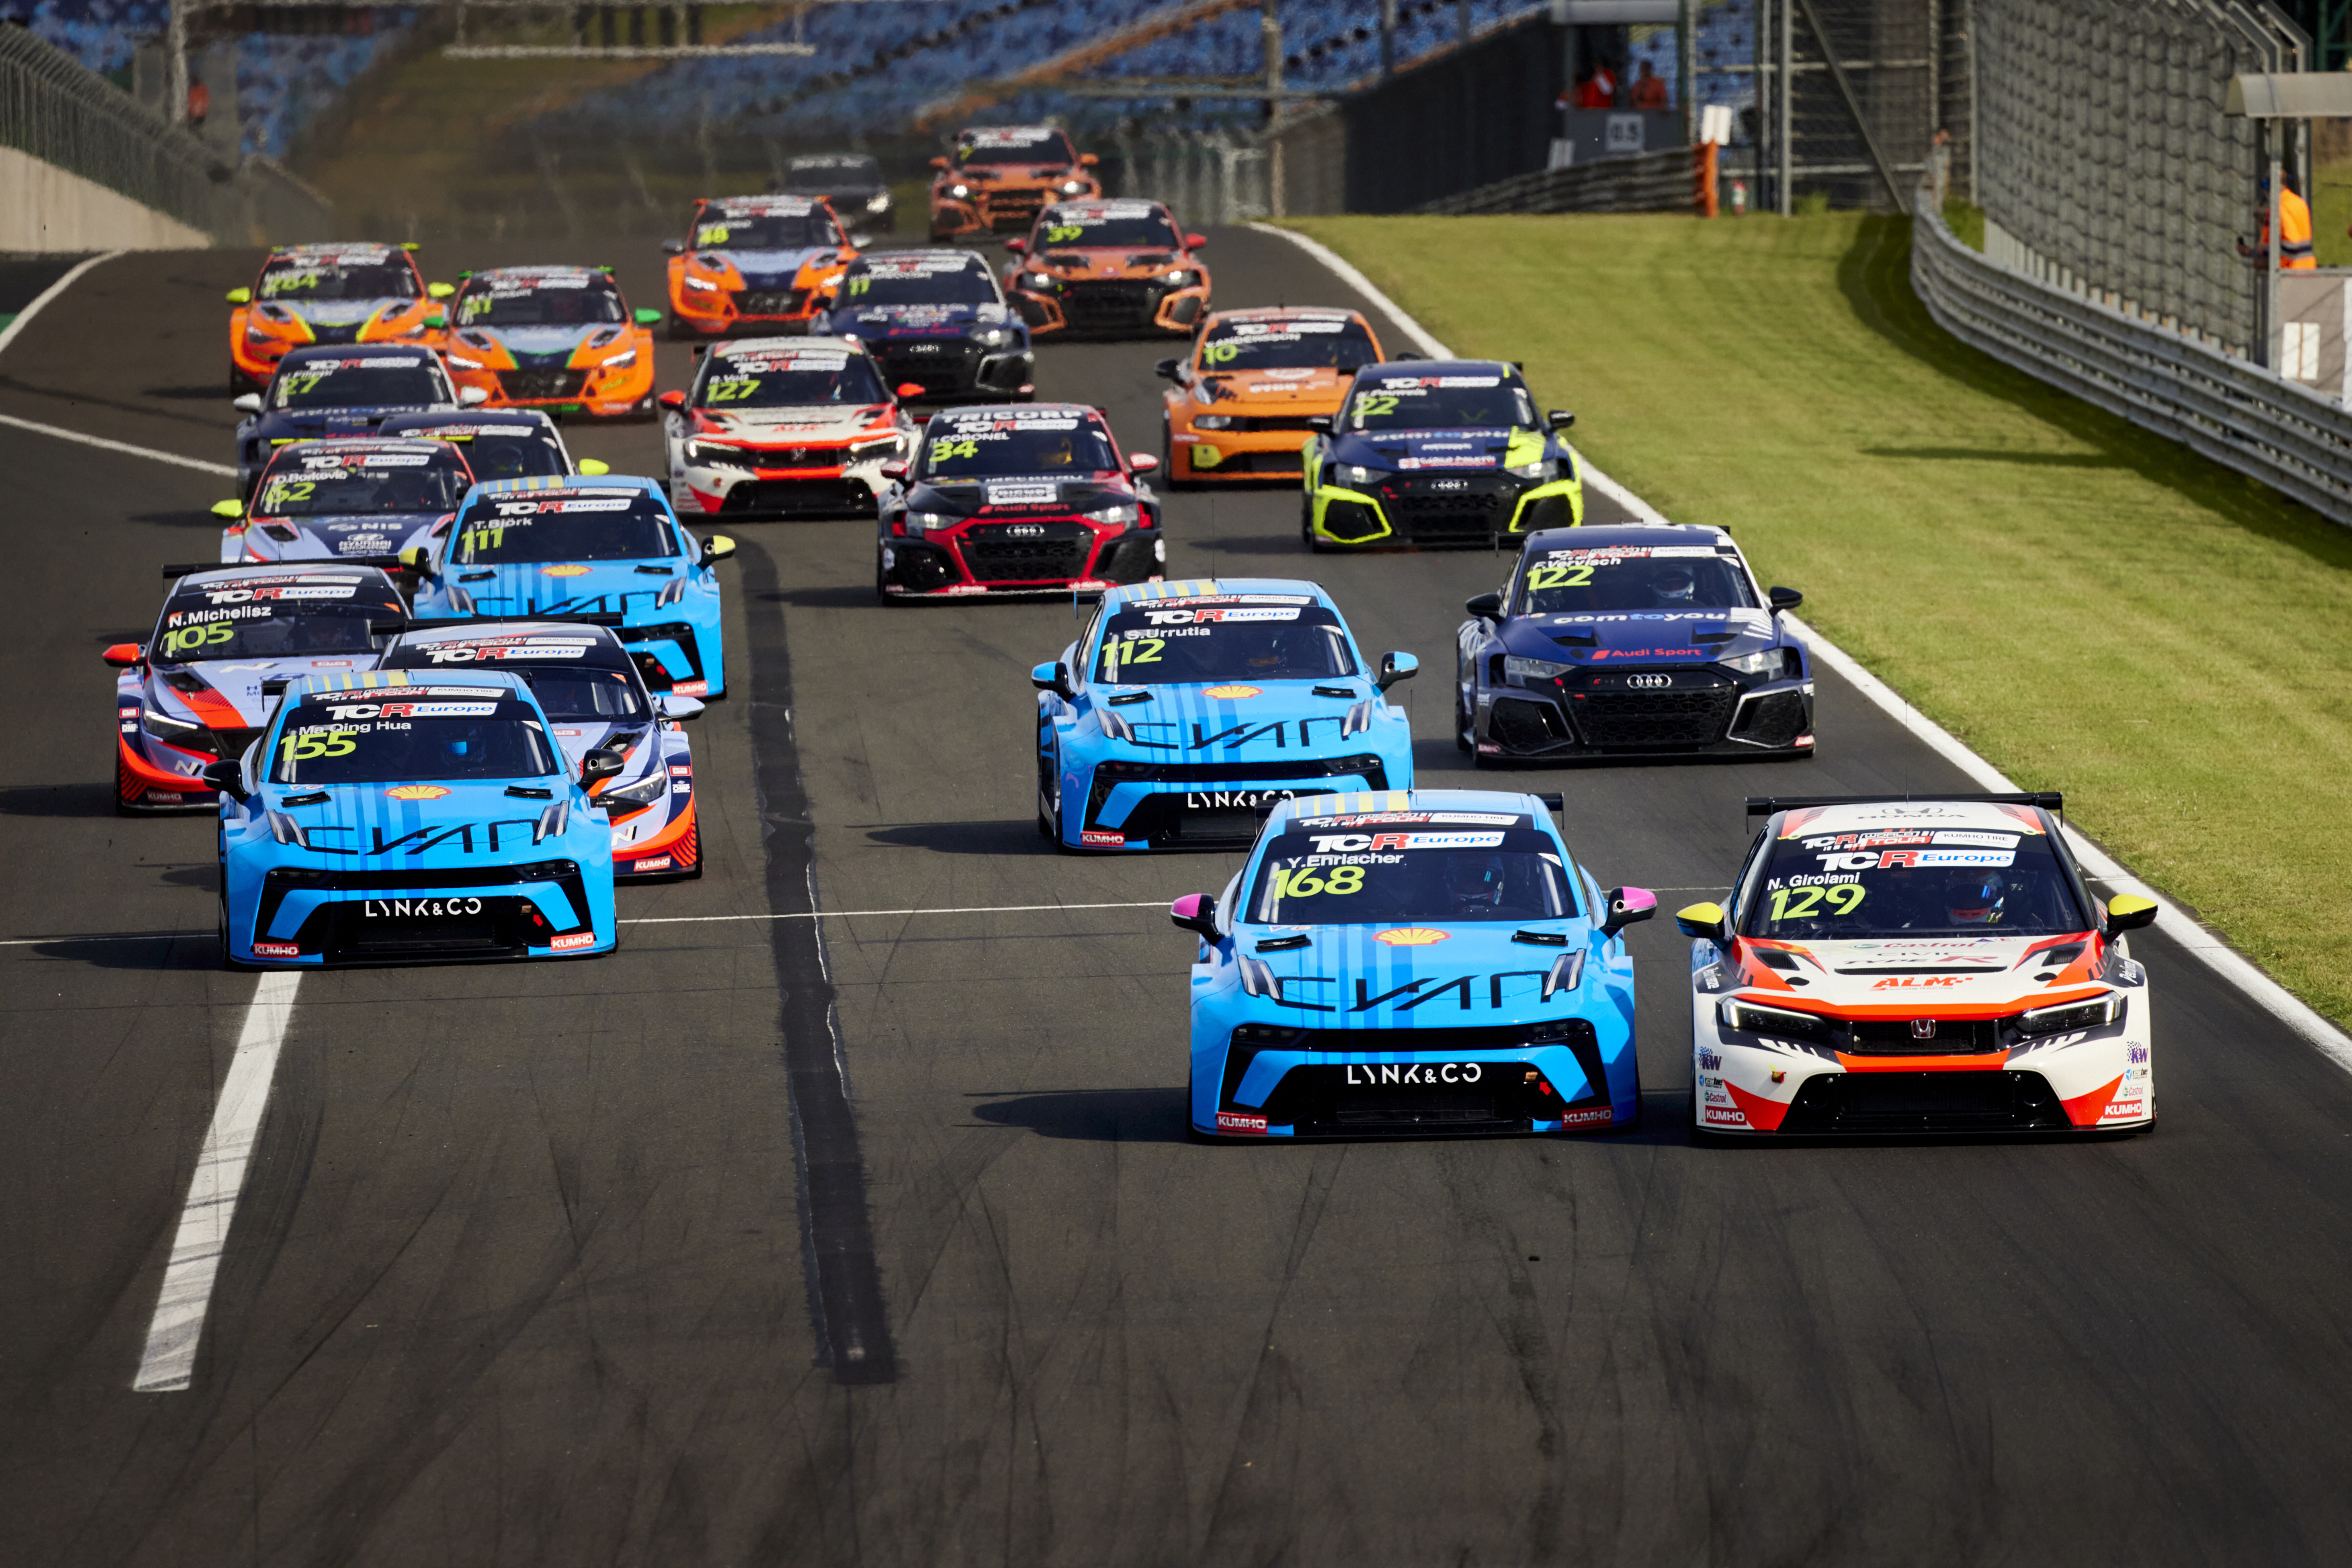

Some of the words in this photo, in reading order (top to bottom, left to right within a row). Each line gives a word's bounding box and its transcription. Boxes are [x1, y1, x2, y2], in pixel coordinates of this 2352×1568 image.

[1046, 226, 1083, 243] 39
[849, 279, 871, 296] 11
[1203, 343, 1238, 363] 10
[279, 376, 321, 396] 27
[707, 380, 761, 402] 127
[1350, 396, 1399, 417] 22
[942, 410, 1082, 423] TRICORP
[929, 440, 978, 462] 34
[265, 482, 316, 503] 62
[495, 500, 564, 516] TCR
[474, 517, 533, 530] T.Björk
[462, 529, 503, 552] 111
[1533, 556, 1621, 570] F.Vervisch
[1527, 565, 1595, 590] 122
[206, 588, 283, 604] TCR
[169, 605, 271, 627] N.Michelisz
[1144, 609, 1225, 624] TCR
[1554, 612, 1725, 624] comtoyou
[163, 621, 234, 652] 105
[1127, 627, 1210, 641] S.Urrutia
[426, 647, 507, 663] TCR
[1102, 639, 1165, 666] 112
[1612, 648, 1649, 657] Audi
[1654, 648, 1701, 658] Sport
[673, 682, 708, 694] KUMHO
[326, 703, 414, 720] TCR
[417, 705, 493, 713] Europe
[299, 725, 321, 735] Ma
[329, 722, 371, 734] Qing
[377, 721, 411, 731] Hua
[280, 731, 358, 761] 155
[673, 784, 691, 793] OMP
[147, 793, 181, 801] KUMHO
[1299, 815, 1356, 826] TCR
[1082, 834, 1123, 843] KUMHO
[1309, 834, 1410, 852] TCR
[1413, 835, 1500, 844] Europe
[1802, 834, 1858, 849] TCR
[635, 858, 670, 869] KUMHO
[1288, 853, 1404, 869] Y.Ehrlacher
[1816, 851, 1919, 871] TCR
[1923, 854, 2010, 863] Europe
[1273, 866, 1366, 898] 168
[1767, 877, 1784, 890] N.
[1789, 872, 1860, 887] Girolami
[1770, 883, 1865, 920] 129
[552, 934, 594, 949] KUMHO
[254, 945, 298, 955] KUMHO
[1872, 977, 1956, 988] ALM
[1702, 1055, 1722, 1070] KW
[2132, 1048, 2148, 1063] KW
[1709, 1092, 1726, 1103] Castrol
[2128, 1086, 2143, 1096] Castrol
[1706, 1109, 1745, 1122] KUMHO
[2105, 1102, 2142, 1115] KUMHO
[1218, 1116, 1266, 1129] KUMHO
[1564, 1110, 1611, 1123] KUMHO
